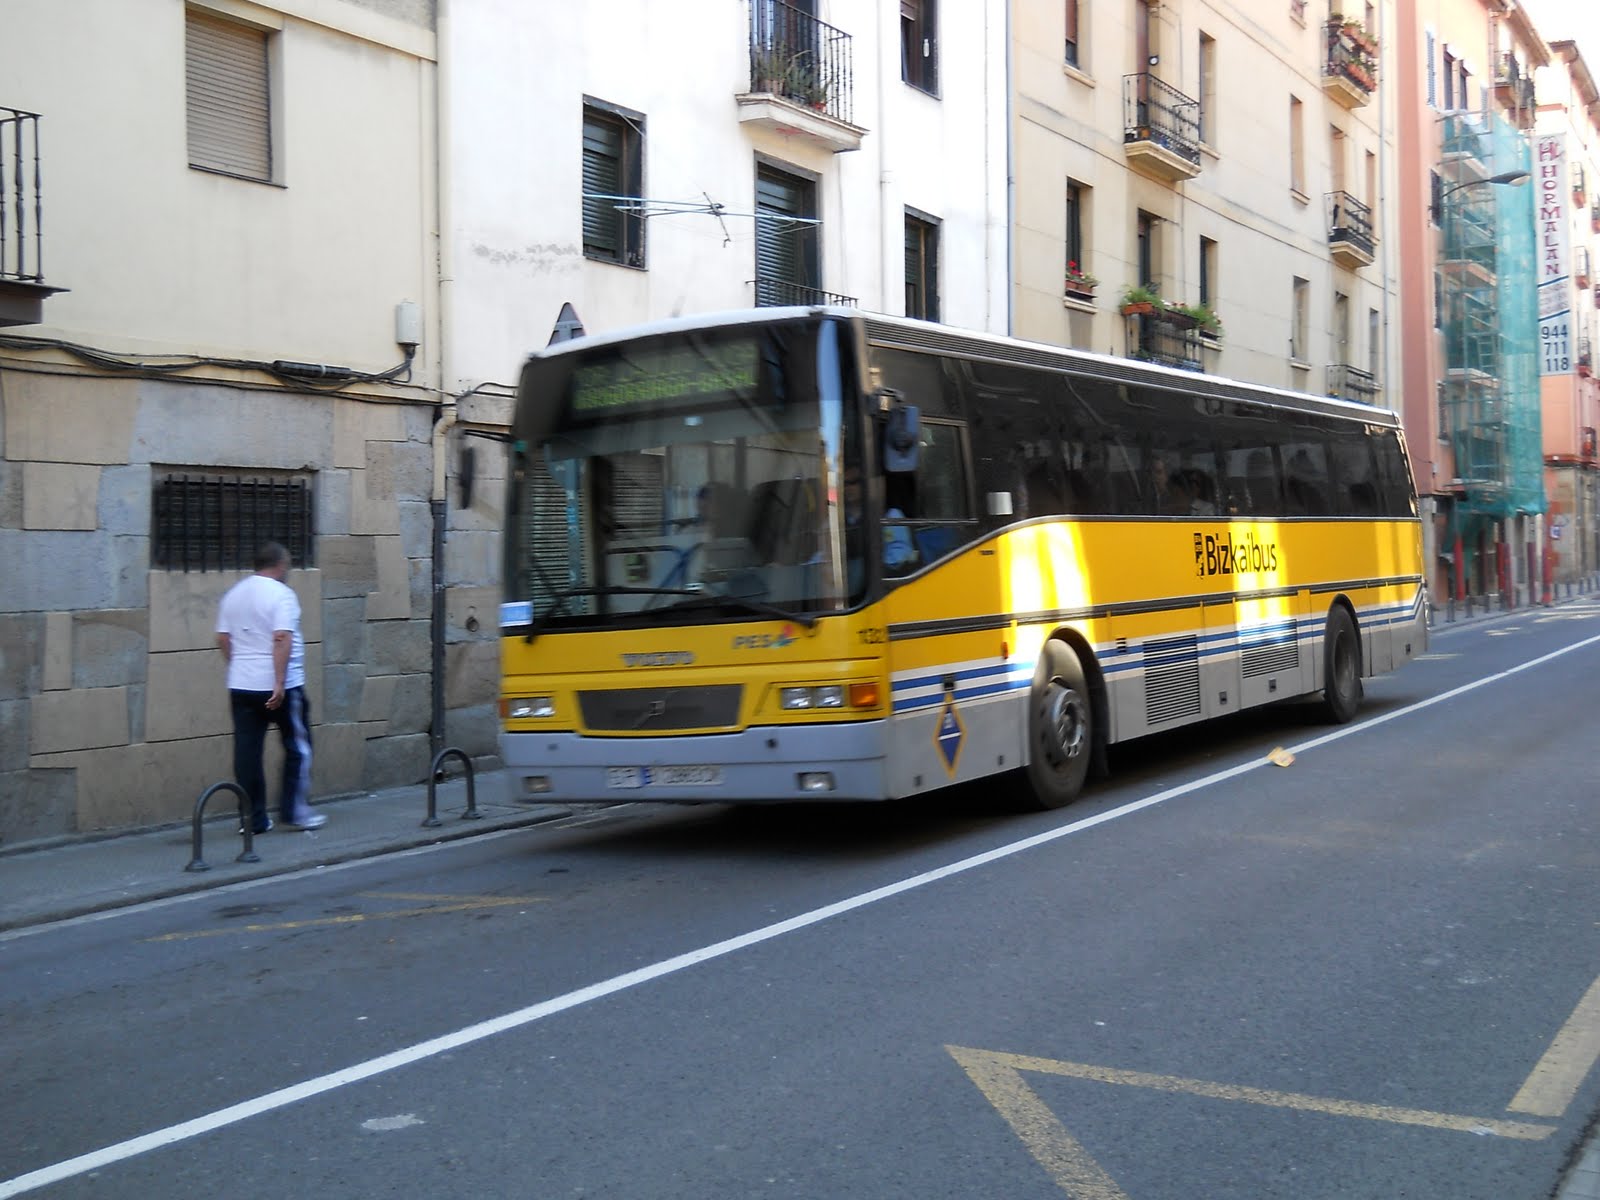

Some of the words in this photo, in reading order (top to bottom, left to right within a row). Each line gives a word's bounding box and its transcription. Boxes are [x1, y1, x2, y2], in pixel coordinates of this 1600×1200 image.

[1540, 165, 1561, 275] HORMALAN
[1541, 325, 1568, 340] 944
[1543, 341, 1567, 356] 711
[1545, 357, 1569, 372] 118
[1205, 532, 1277, 575] Bizkaibus
